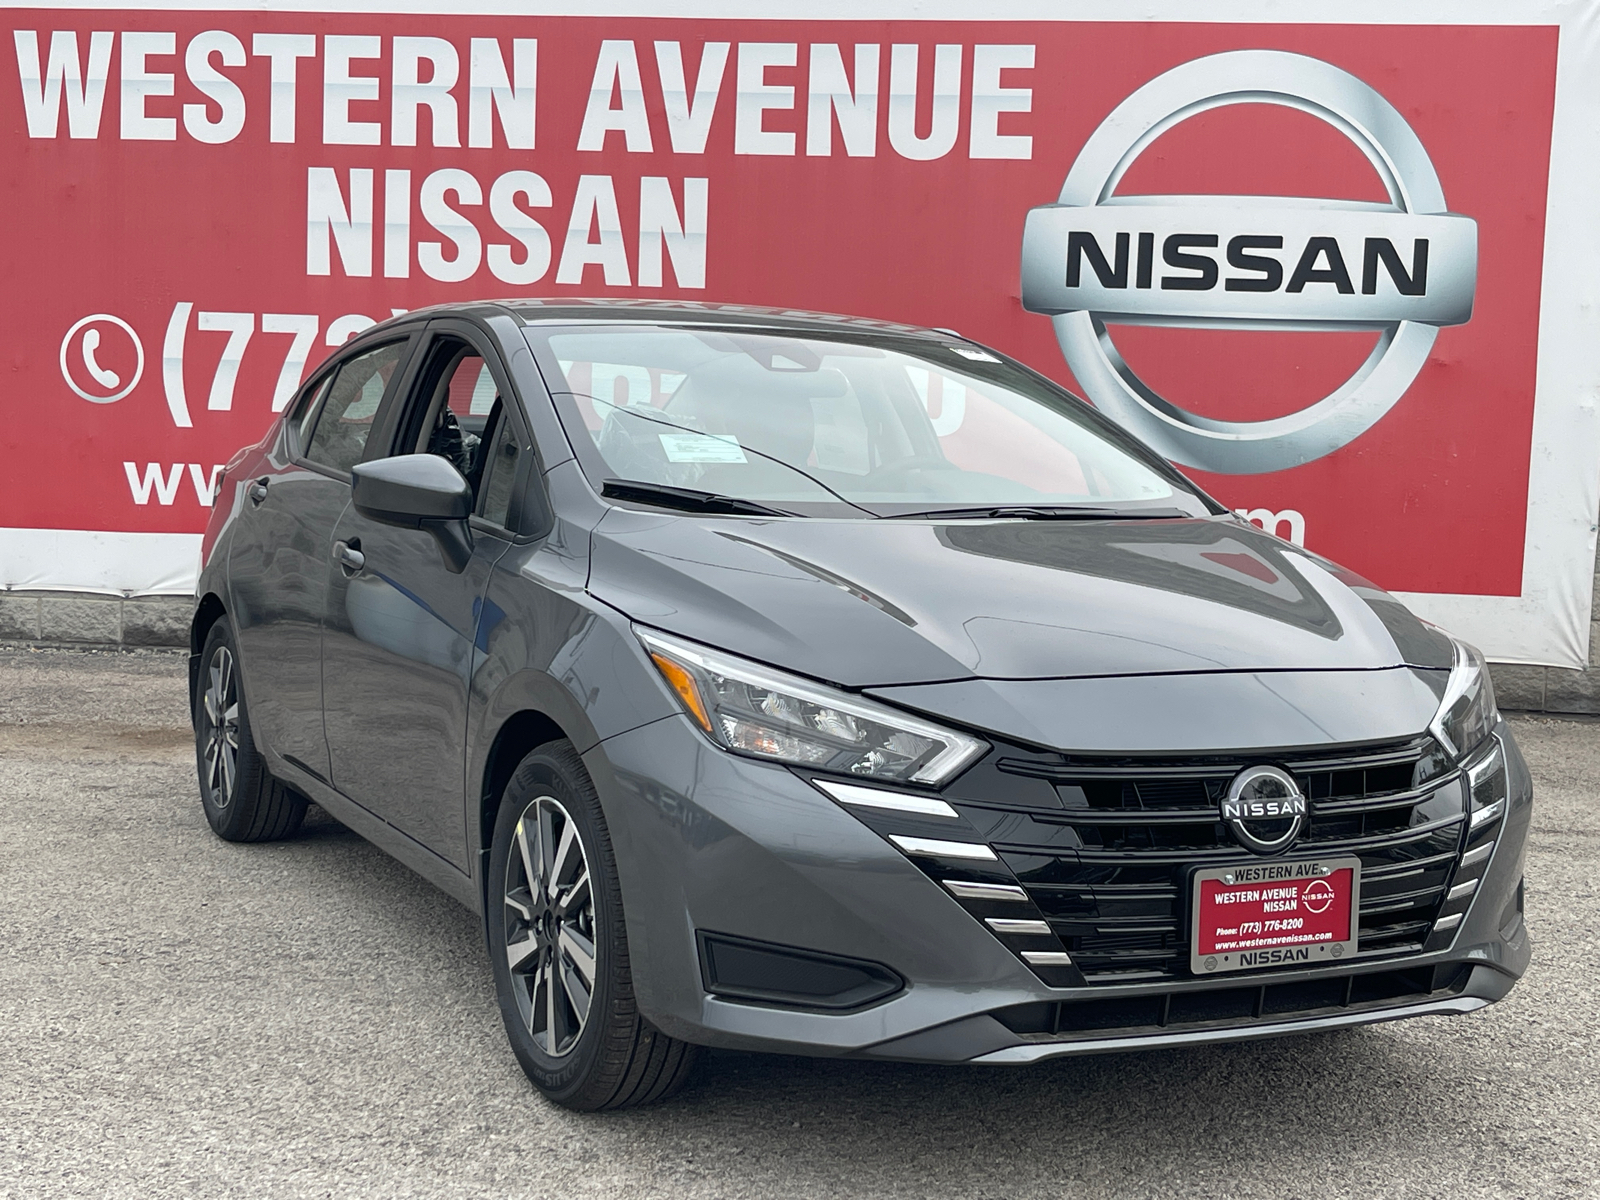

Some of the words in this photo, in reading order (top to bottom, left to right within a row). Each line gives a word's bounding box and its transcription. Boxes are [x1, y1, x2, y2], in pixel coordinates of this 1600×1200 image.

[14, 29, 538, 150] WESTERN
[577, 39, 1036, 162] AVENUE
[306, 166, 709, 289] NISSAN
[1065, 231, 1430, 297] NISSAN
[1225, 800, 1306, 817] NISSAN
[1235, 866, 1293, 881] WESTERN
[1215, 890, 1260, 905] WESTERN
[1262, 887, 1298, 901] AVENUE
[1302, 892, 1335, 901] NISSAN
[1264, 900, 1298, 913] NISSAN
[1216, 928, 1238, 936] Phone:
[1239, 922, 1262, 937] (773)
[1264, 918, 1304, 932] 776-8200
[1215, 932, 1333, 950] www.westernavenissan.com
[1240, 947, 1309, 967] NISSAN
